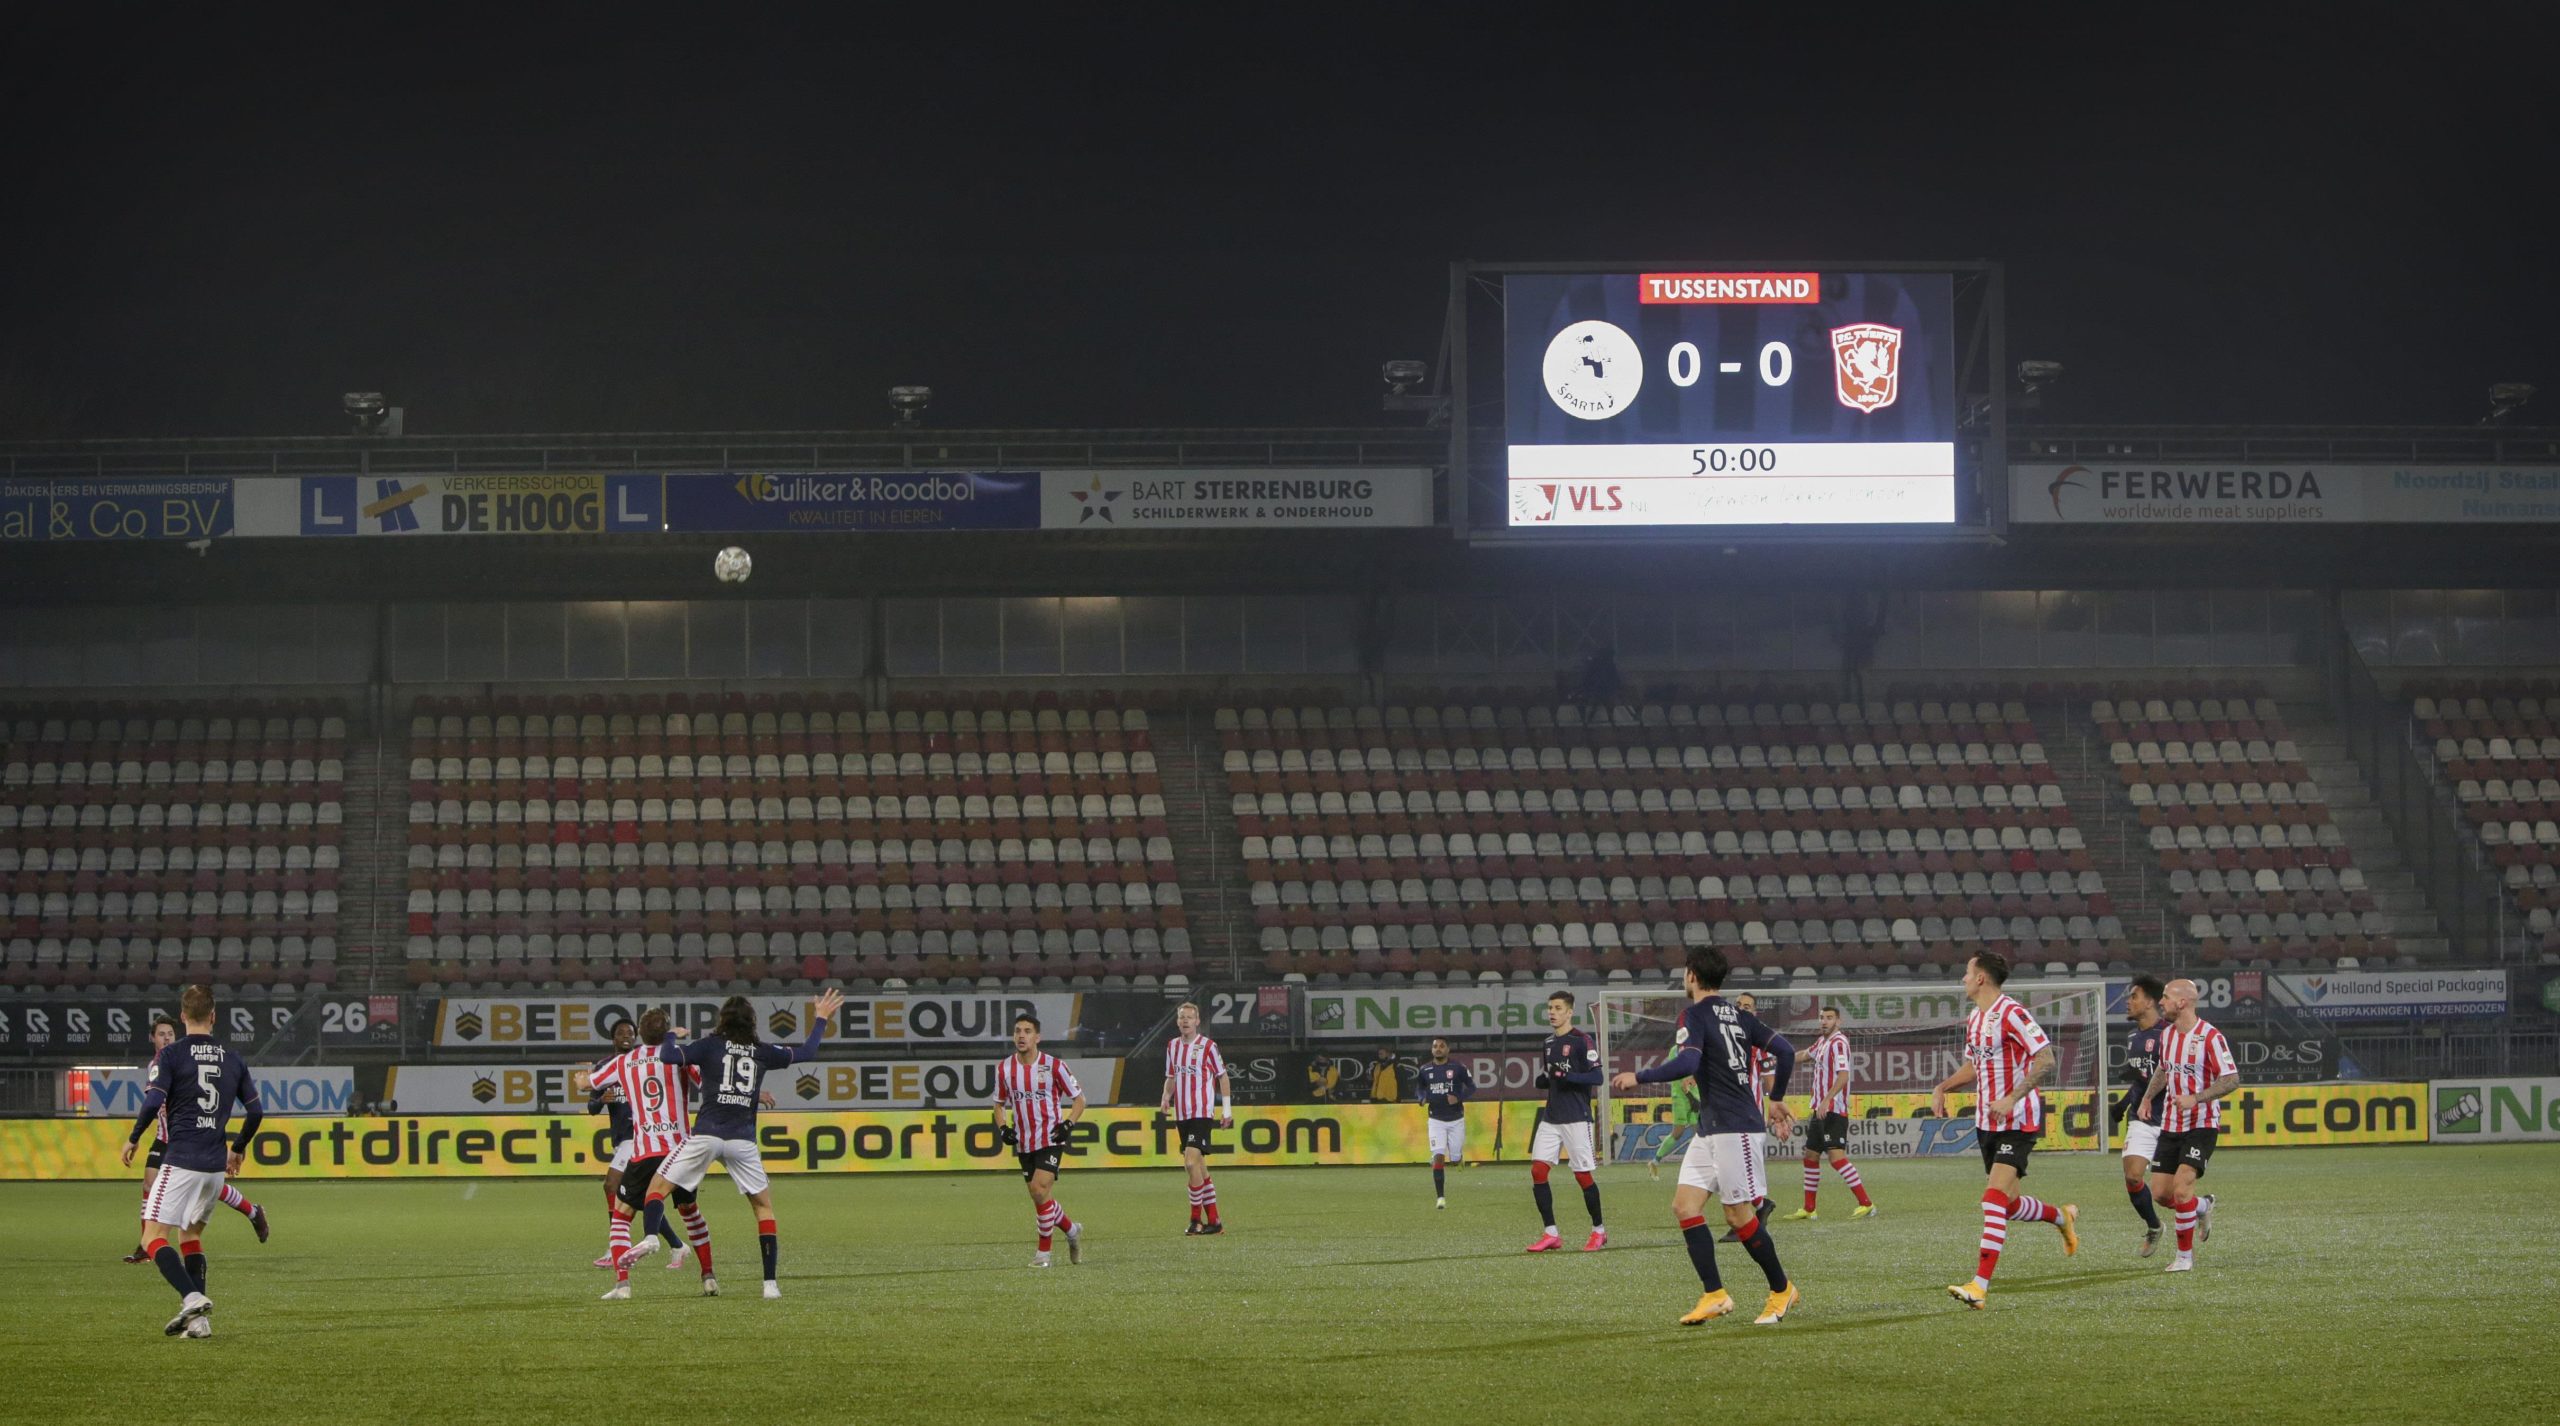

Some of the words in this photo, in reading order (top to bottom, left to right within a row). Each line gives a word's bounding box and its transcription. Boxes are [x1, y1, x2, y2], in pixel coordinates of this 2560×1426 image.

[1649, 279, 1810, 299] TUSSENSTAND
[1667, 341, 1701, 387] 0
[1759, 341, 1793, 387] 0
[1557, 386, 1605, 412] SPARTA
[1691, 448, 1777, 476] 50:00
[5, 485, 79, 497] DAKDEKKERS
[82, 484, 98, 496] EN
[100, 482, 228, 496] VERWARMINGSBEDRIJF
[442, 476, 599, 490] VERKEERSSCHOOL
[760, 475, 846, 502] Guliker
[849, 476, 867, 501] &
[870, 474, 975, 501] Roodbol
[1132, 481, 1186, 501] BART
[1193, 479, 1373, 500] STERRENBURG
[2100, 469, 2322, 500] FERWERDA
[2394, 470, 2490, 493] Noordzij
[314, 487, 344, 525] L
[618, 485, 649, 523] L
[1568, 485, 1623, 512] VLS
[0, 501, 34, 538] al
[50, 502, 76, 539] &
[89, 500, 148, 538] Co
[162, 499, 221, 537] BV
[442, 494, 489, 532] DE
[496, 493, 599, 532] HOOG
[788, 509, 864, 525] KWALITEIT
[870, 508, 886, 524] IN
[891, 507, 943, 524] EIEREN
[1132, 506, 1249, 520] SCHILDERWERK
[1255, 506, 1266, 519] &
[1273, 505, 1374, 519] ONDERHOUD
[2103, 504, 2193, 519] worldwide
[2199, 505, 2241, 519] meat
[2246, 503, 2324, 522] suppliers
[2192, 977, 2232, 1009] 28
[2331, 980, 2382, 994] Holland
[2386, 979, 2433, 995] Special
[2438, 978, 2504, 994] Packaging
[321, 1002, 368, 1033] 26
[1211, 993, 1257, 1024] 27
[2419, 1003, 2505, 1016] VERZENDDOZEN
[26, 1033, 51, 1043] ROBEY
[67, 1033, 91, 1043] ROBEY
[107, 1033, 132, 1043] ROBEY
[190, 1044, 213, 1055] pure
[230, 1032, 255, 1042] ROBEY
[194, 1053, 219, 1063] energie
[2237, 1040, 2323, 1065] D&S
[719, 1053, 758, 1096] 19
[1225, 1058, 1277, 1083] &S
[1329, 1056, 1420, 1081] DS
[197, 1064, 222, 1114] 5
[642, 1076, 665, 1112] 9
[827, 1063, 998, 1101] BEEQU
[1848, 1120, 1879, 1136] elft
[1886, 1120, 1908, 1135] bv
